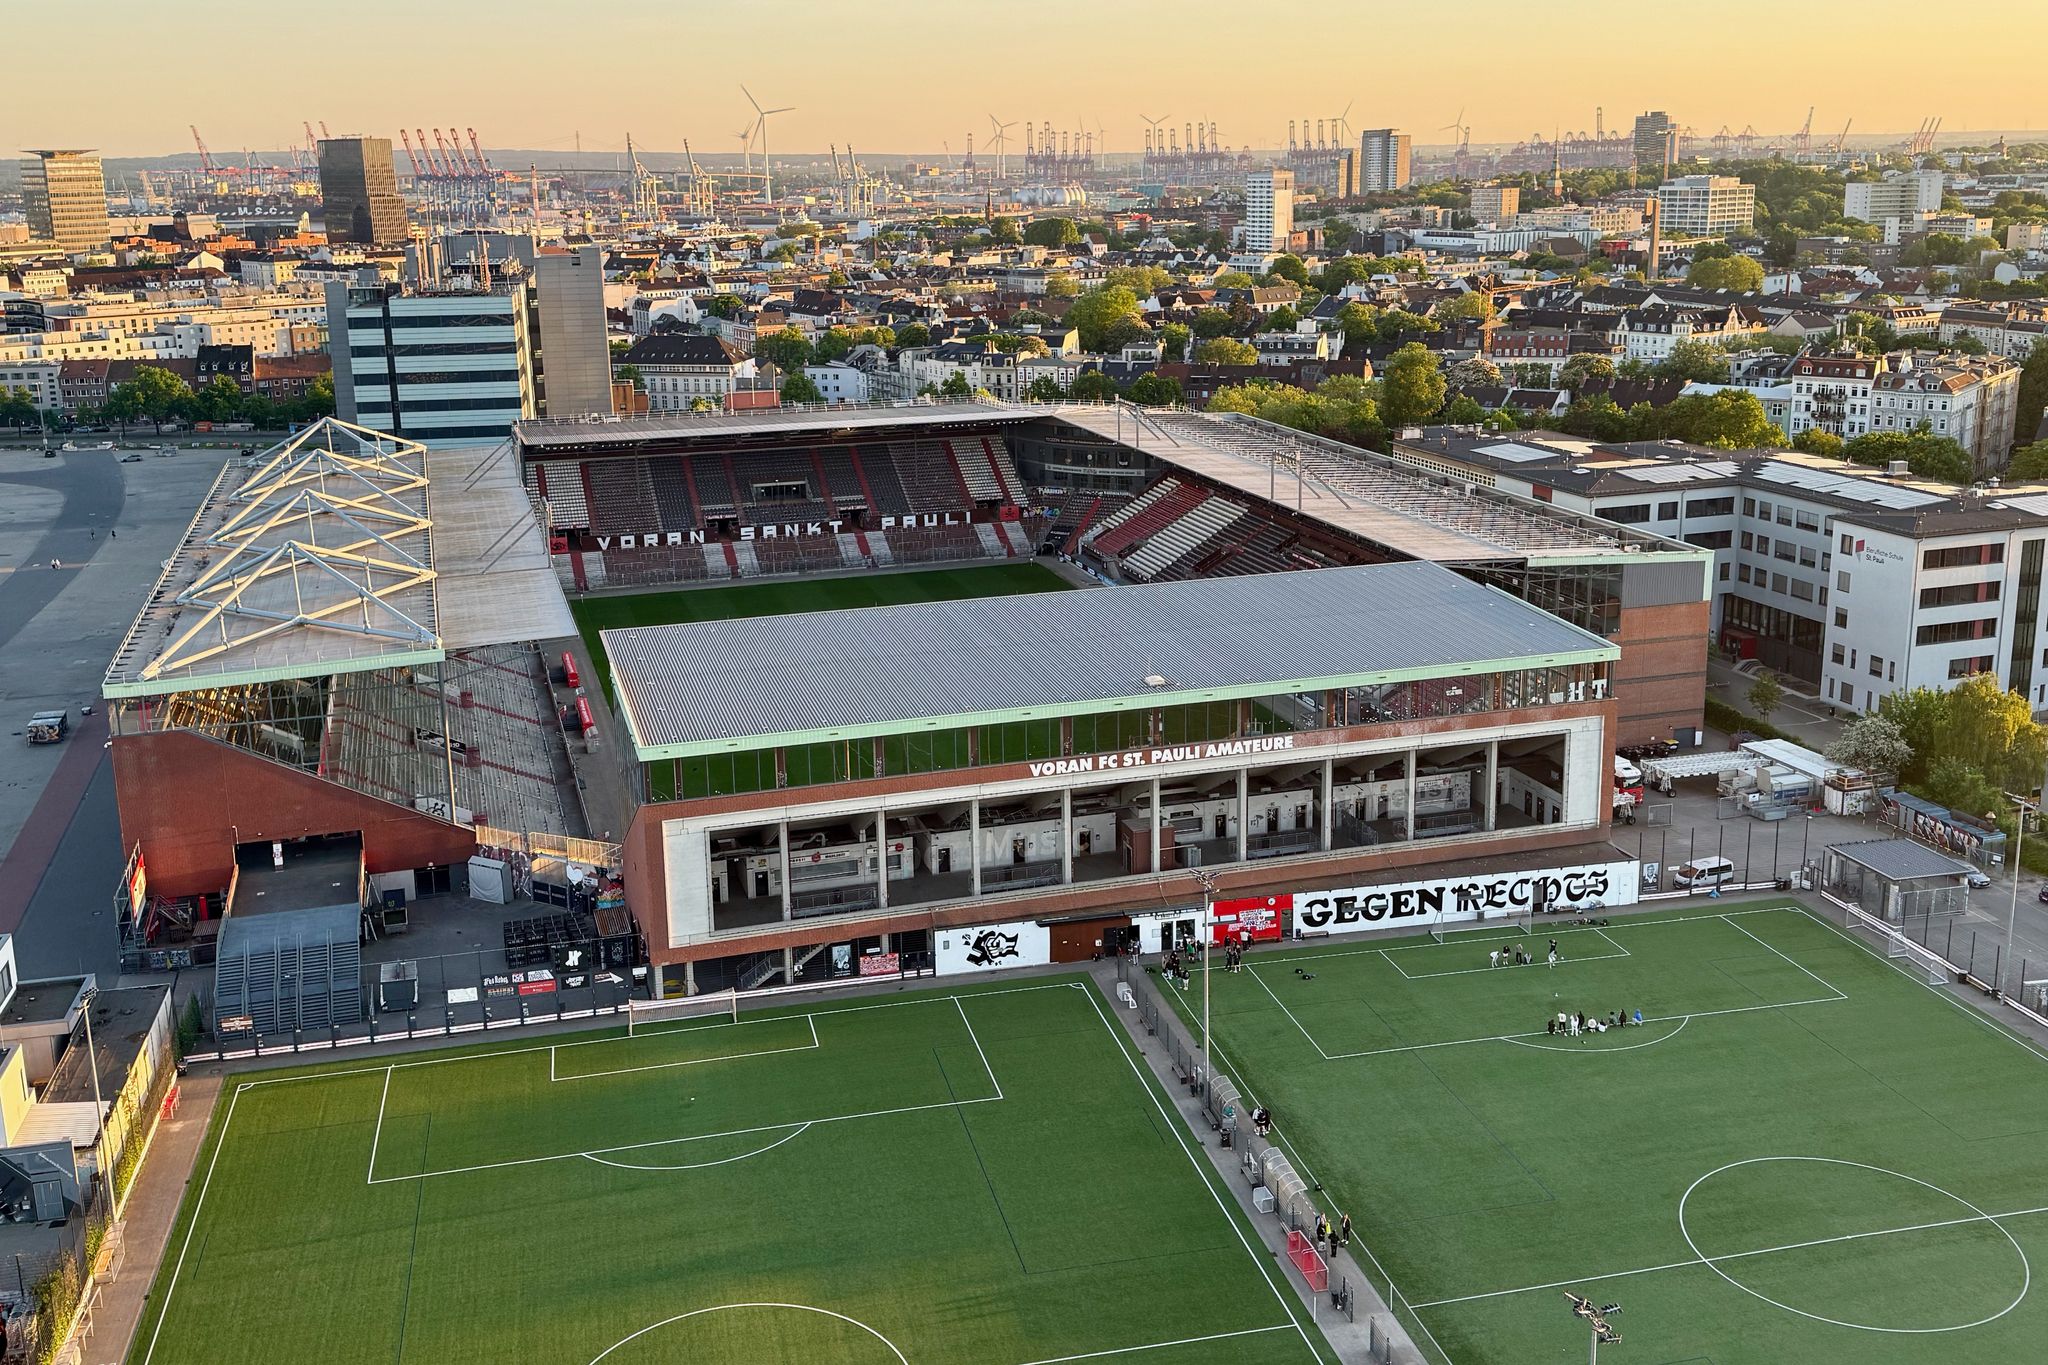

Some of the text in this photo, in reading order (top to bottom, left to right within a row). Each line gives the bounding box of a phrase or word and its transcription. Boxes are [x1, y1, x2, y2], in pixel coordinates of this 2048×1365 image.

[596, 511, 971, 551] VORAN SANKT PAULI
[1029, 735, 1294, 777] VORAN FC ST. PAULI AMATEURE
[1300, 886, 1446, 928] GEGEN
